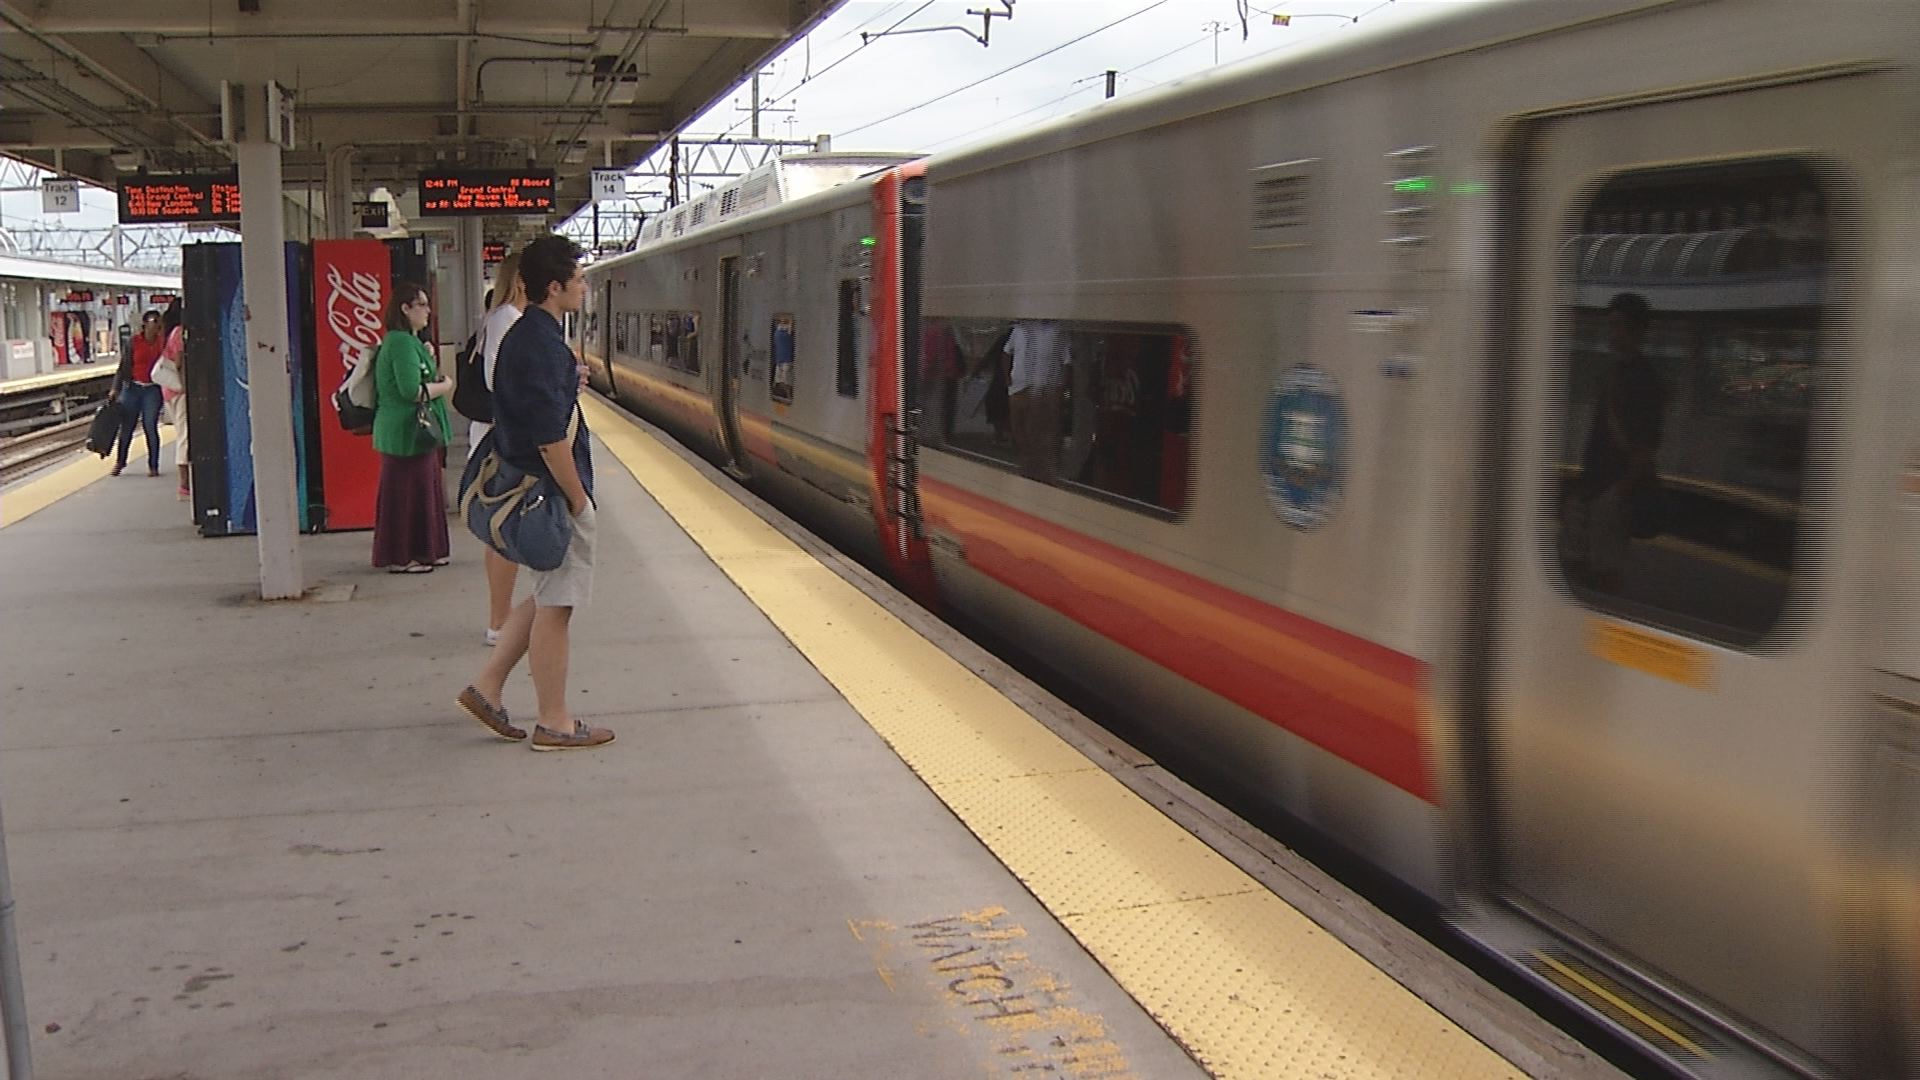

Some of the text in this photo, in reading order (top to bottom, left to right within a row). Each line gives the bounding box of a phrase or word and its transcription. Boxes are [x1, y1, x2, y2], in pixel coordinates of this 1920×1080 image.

[594, 172, 625, 181] Track
[43, 183, 77, 192] Track
[447, 179, 458, 187] PM
[125, 185, 142, 193] Time
[460, 185, 516, 194] Grand Central
[603, 184, 615, 193] 14
[147, 192, 171, 200] Grand
[174, 191, 204, 200] Central
[55, 195, 67, 206] 12
[165, 200, 193, 208] London
[903, 915, 1035, 1021] WATCH
